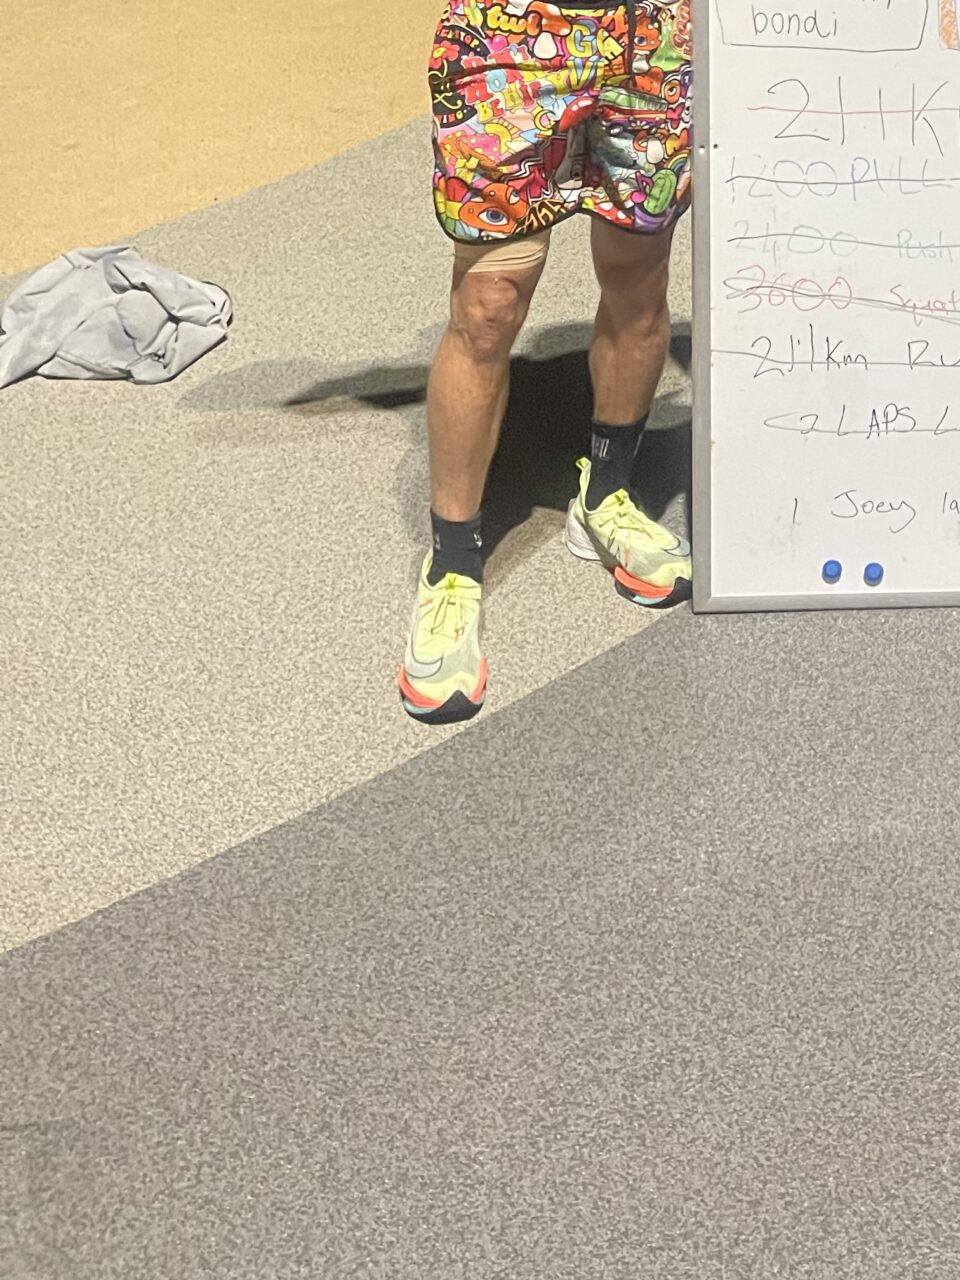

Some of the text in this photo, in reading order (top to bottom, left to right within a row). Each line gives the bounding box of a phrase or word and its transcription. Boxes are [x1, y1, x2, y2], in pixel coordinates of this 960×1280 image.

[752, 5, 837, 38] bondi
[837, 403, 917, 439] LAPS
[830, 489, 917, 534] Joey
